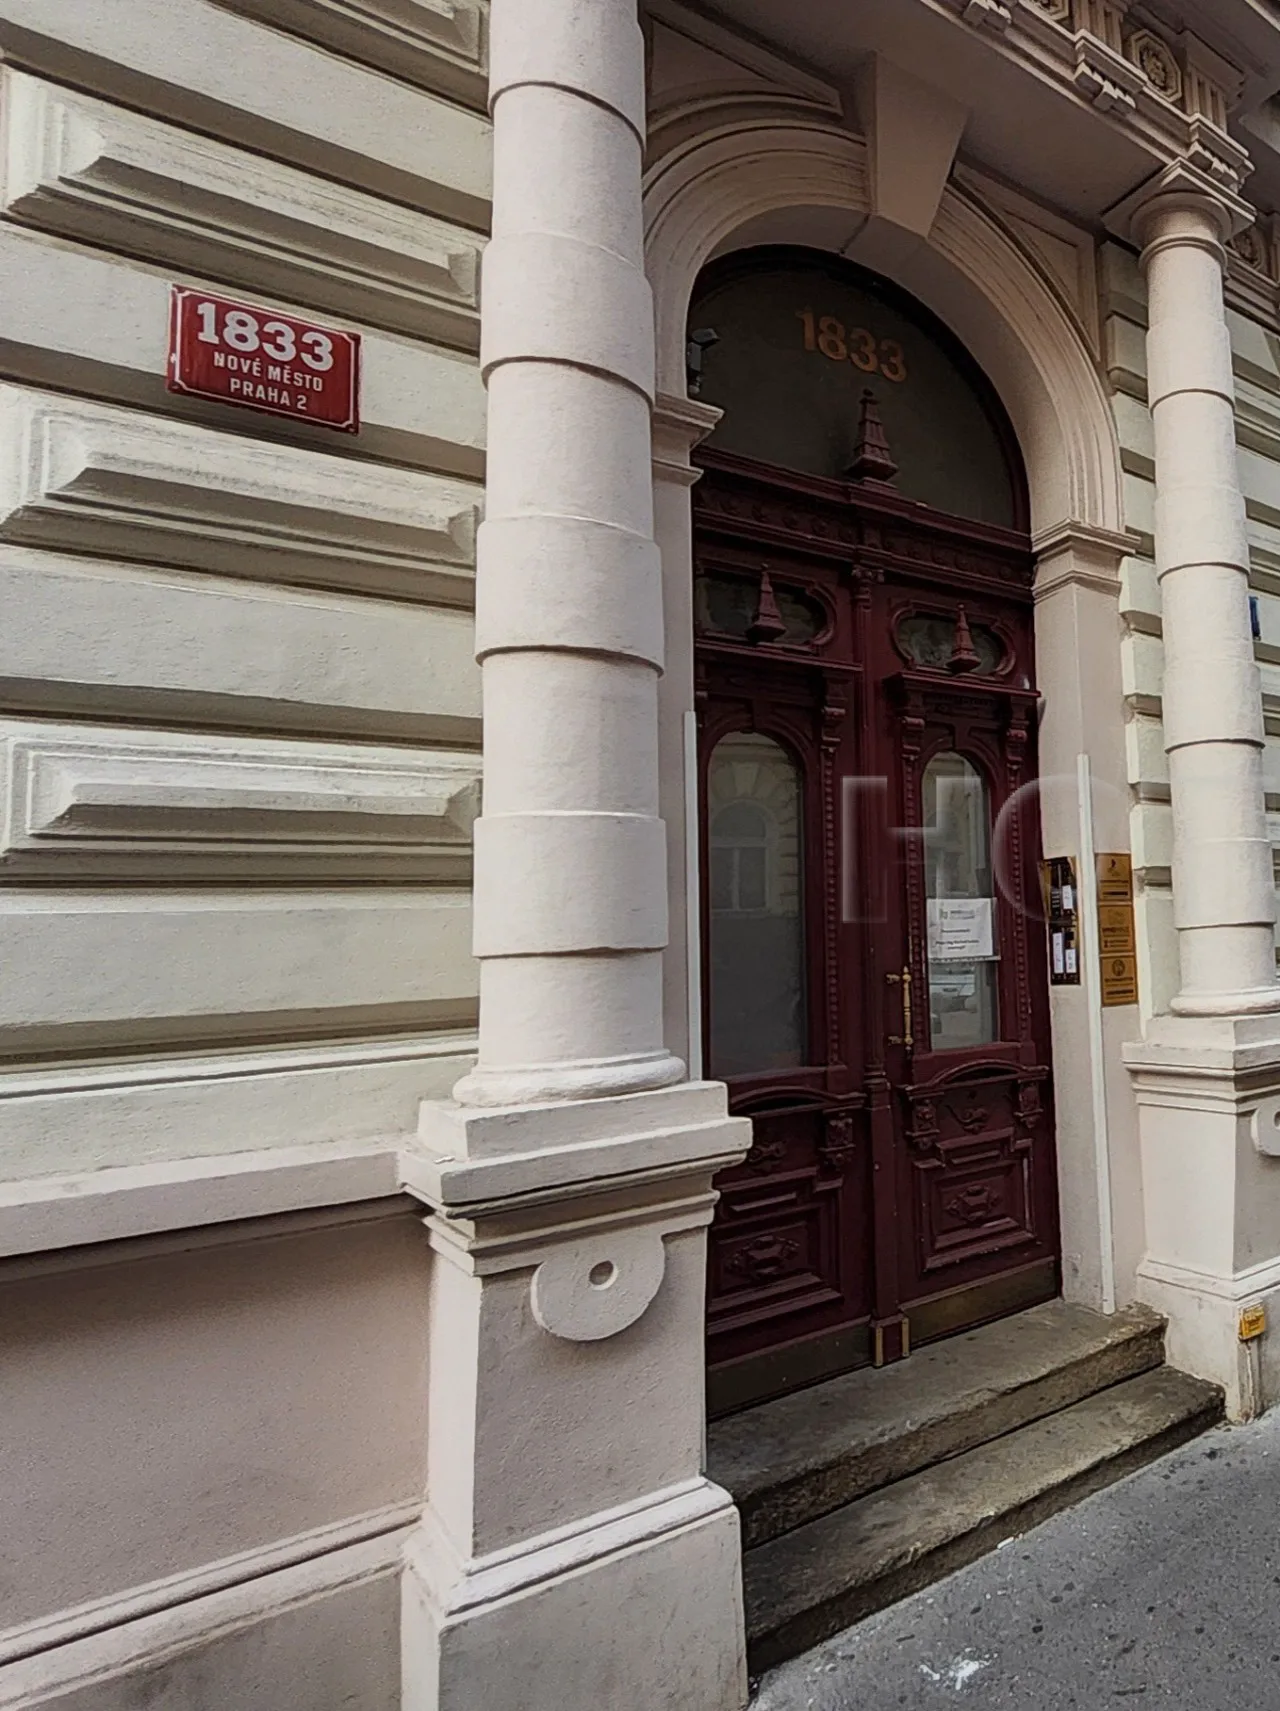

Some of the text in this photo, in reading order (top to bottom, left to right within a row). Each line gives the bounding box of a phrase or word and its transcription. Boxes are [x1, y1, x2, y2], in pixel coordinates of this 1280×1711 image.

[197, 302, 334, 371] 1833
[795, 306, 907, 382] 1833
[213, 351, 323, 392] NOVÉ MĚSTO
[230, 378, 307, 411] PRAHA 2
